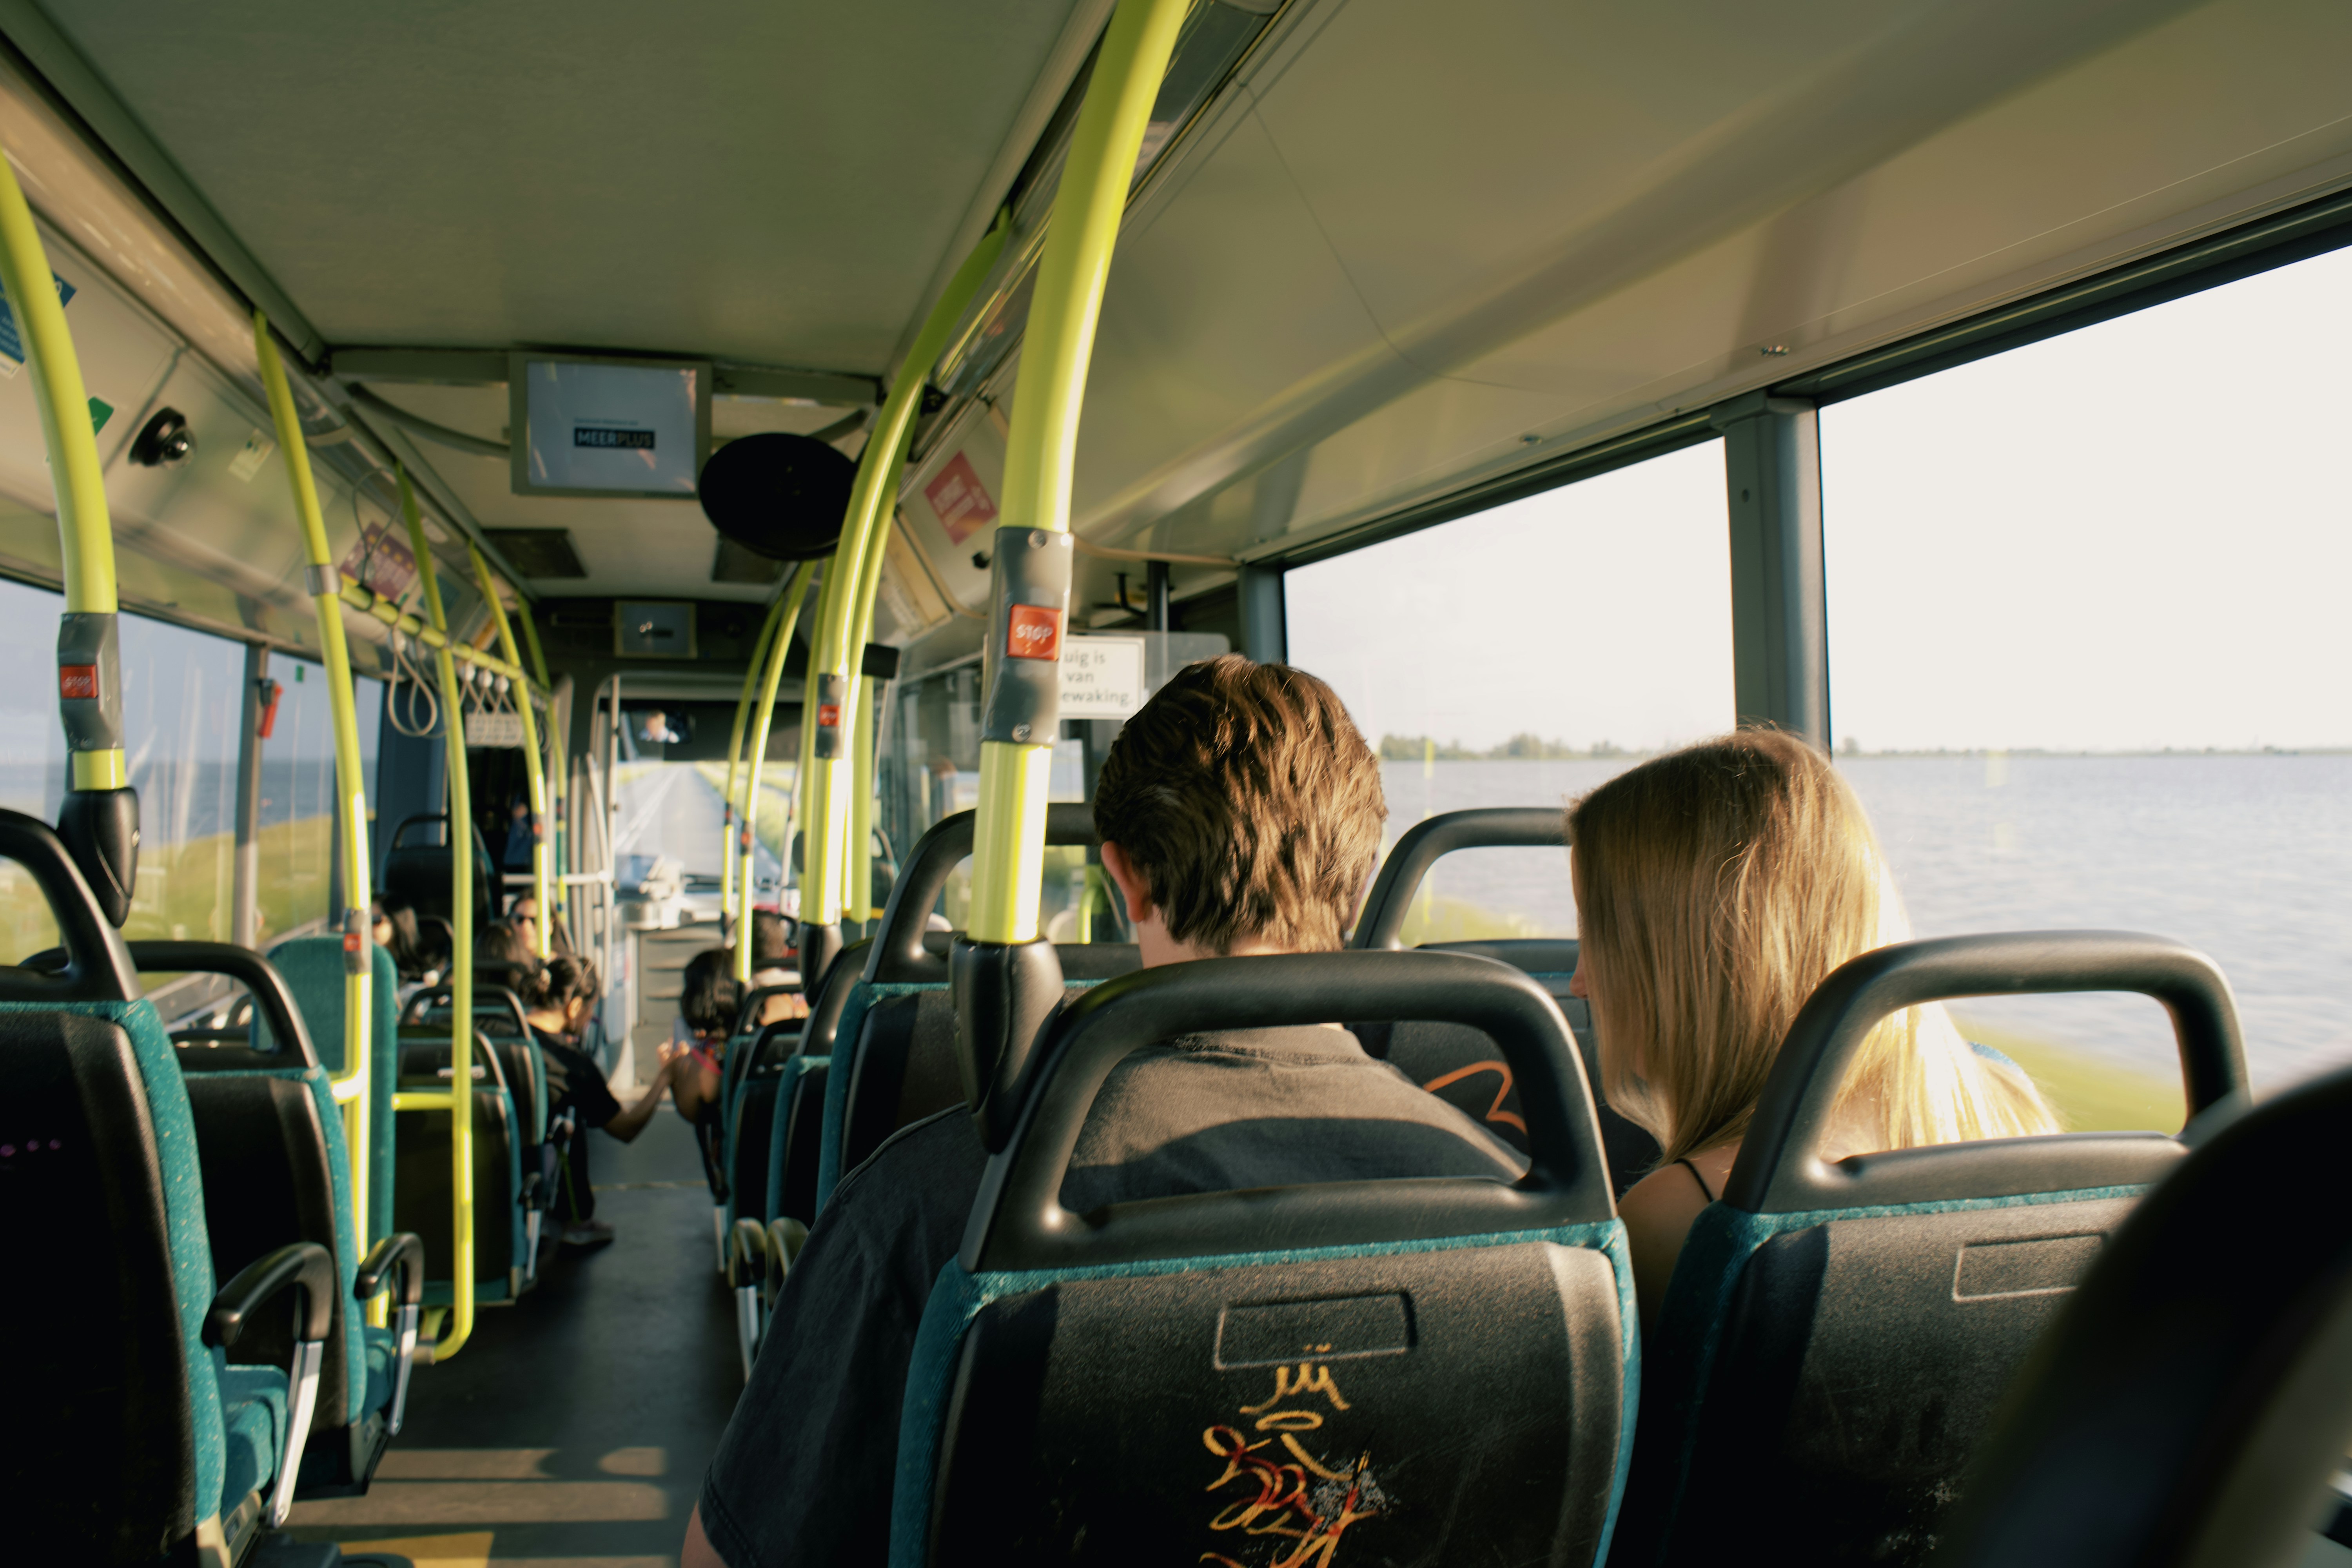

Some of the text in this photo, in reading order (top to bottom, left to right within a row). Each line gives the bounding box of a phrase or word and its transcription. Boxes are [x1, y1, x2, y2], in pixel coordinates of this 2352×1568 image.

[577, 430, 652, 446] MEERPLUS
[1016, 624, 1053, 641] STOP
[1065, 649, 1106, 668] uig is
[1066, 671, 1094, 683] van
[1062, 687, 1133, 708] ewaking.
